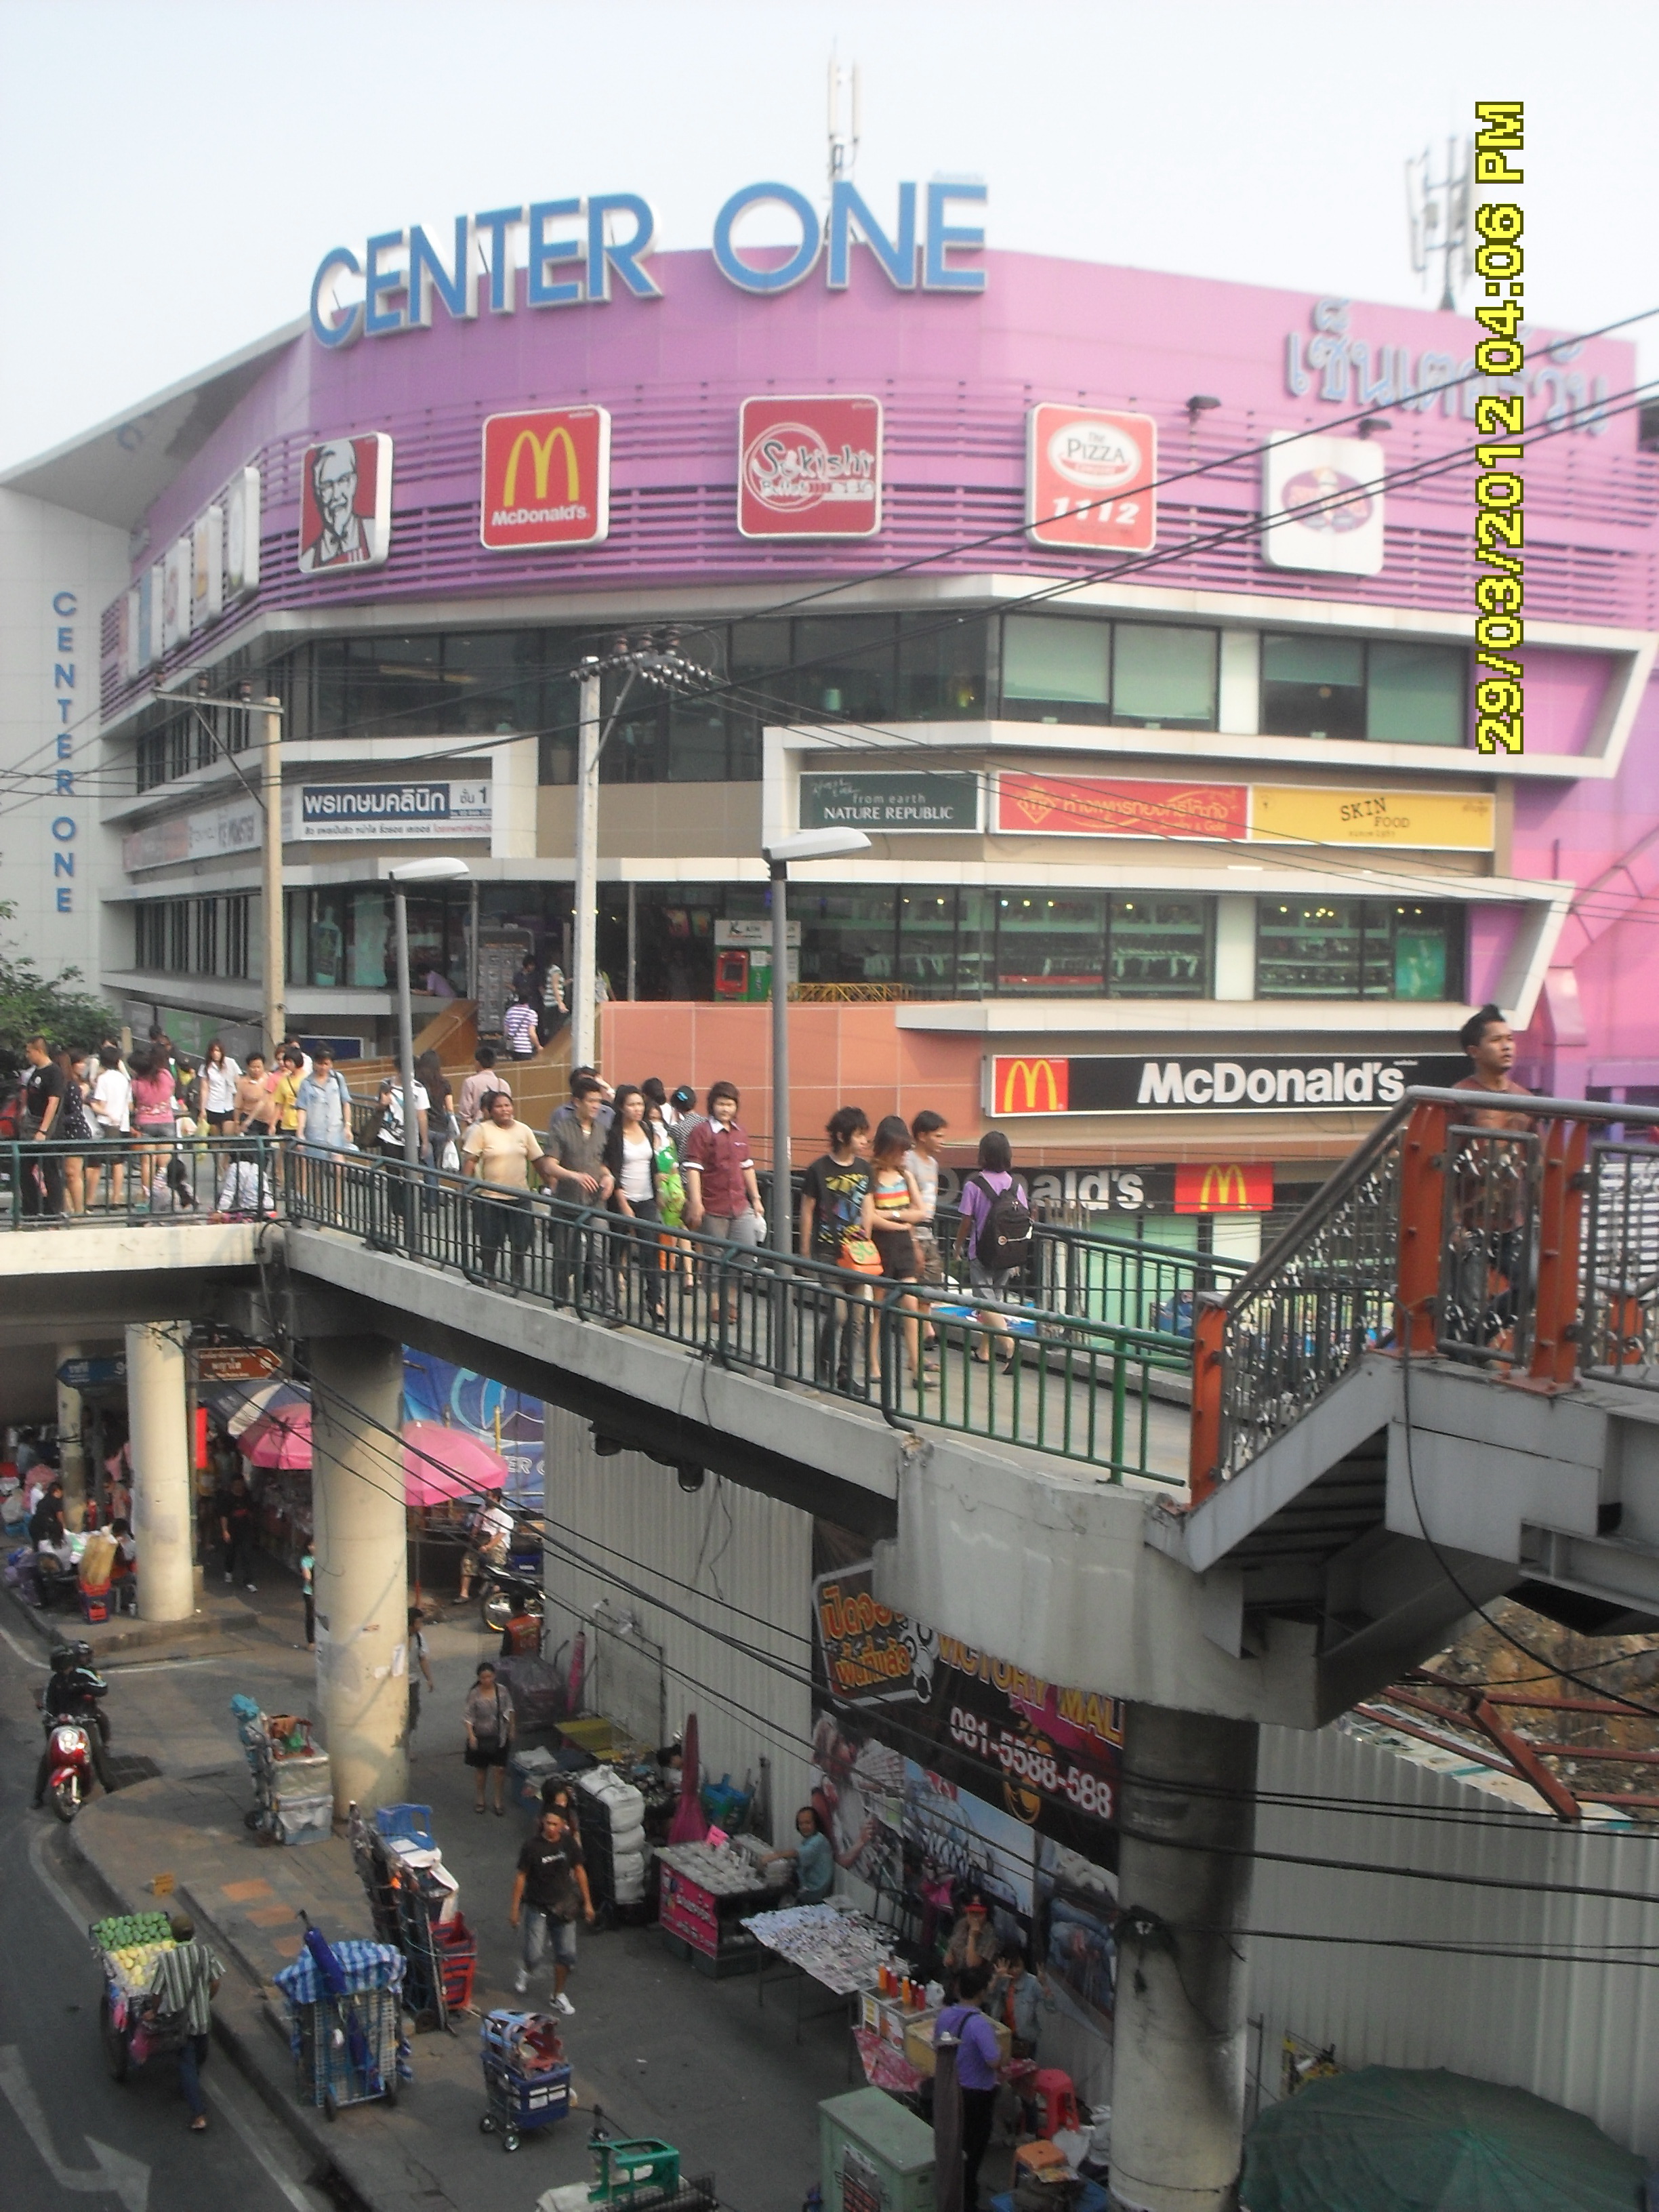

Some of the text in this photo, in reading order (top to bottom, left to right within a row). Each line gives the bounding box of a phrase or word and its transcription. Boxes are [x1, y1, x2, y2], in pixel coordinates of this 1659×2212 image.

[310, 180, 988, 348] CENTER ONE
[1067, 438, 1126, 464] PIZZA
[491, 504, 589, 527] McDonald's
[1052, 497, 1140, 525] 1112
[52, 591, 78, 914] CENTER ONE
[479, 786, 487, 804] 1
[852, 793, 926, 804] from earth
[823, 806, 954, 820] NATURE REPUBLIC
[1340, 797, 1387, 821] SKIN
[1374, 816, 1410, 828] FOOD
[1137, 1062, 1406, 1104] McDonald's
[950, 1706, 1113, 1820] 081-5588-588
